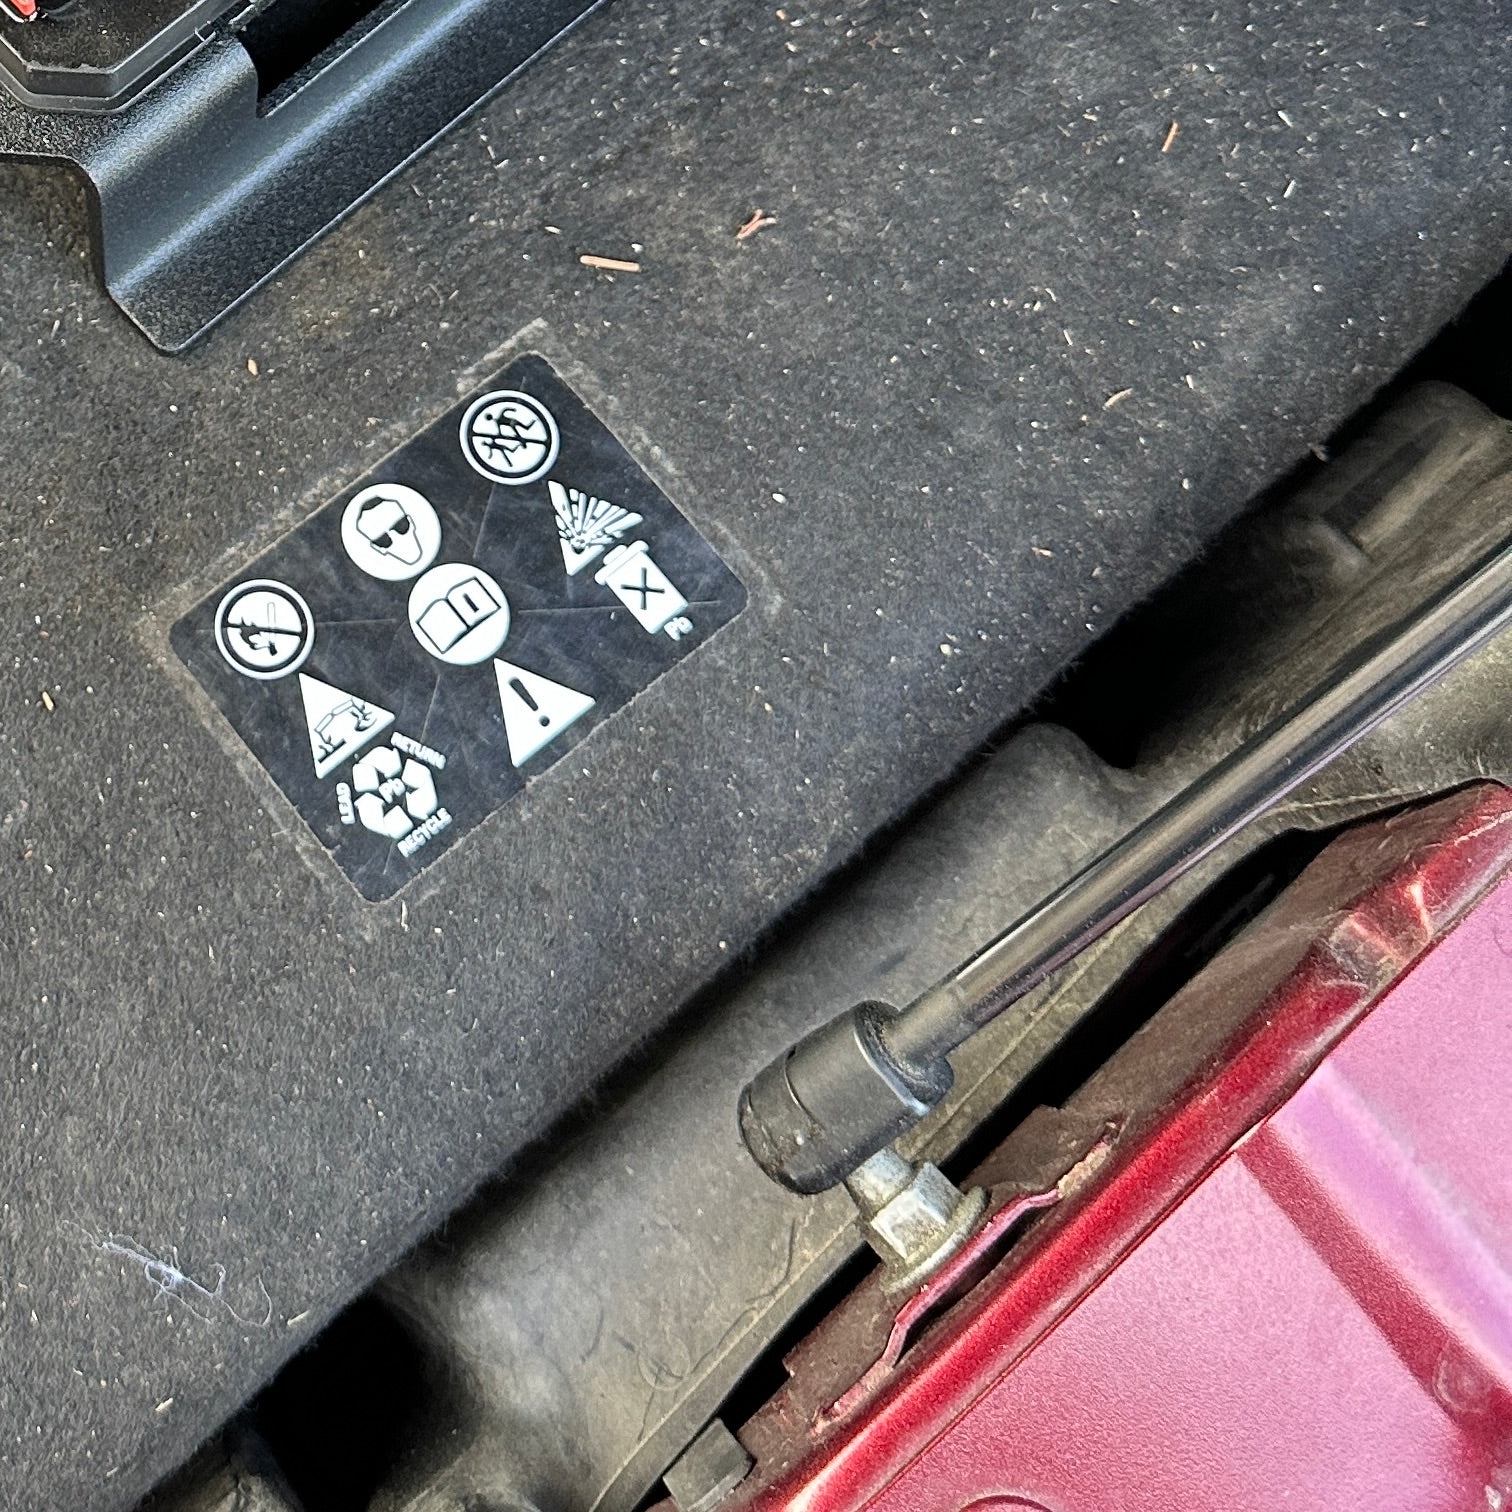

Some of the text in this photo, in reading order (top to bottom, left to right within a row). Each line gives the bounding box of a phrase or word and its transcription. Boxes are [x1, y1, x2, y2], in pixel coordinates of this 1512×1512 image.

[663, 616, 694, 641] Pb
[390, 731, 447, 770] RETURN
[335, 782, 356, 825] LEAD
[378, 777, 406, 804] Pb
[397, 807, 453, 858] RECYCLE
